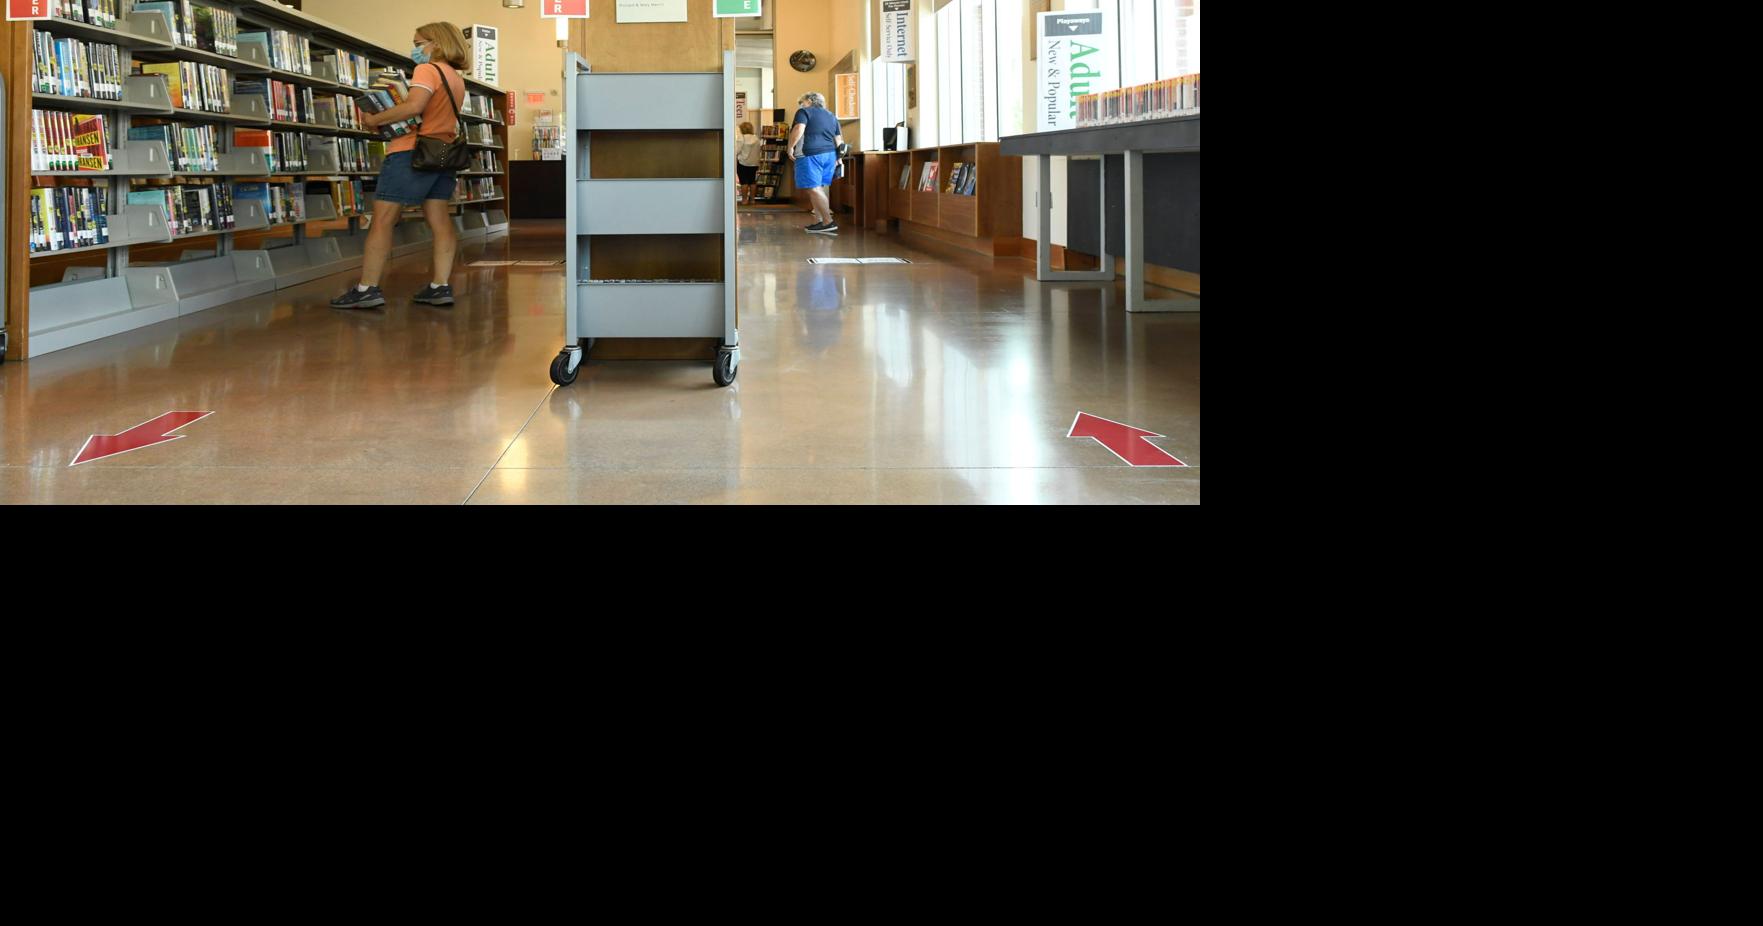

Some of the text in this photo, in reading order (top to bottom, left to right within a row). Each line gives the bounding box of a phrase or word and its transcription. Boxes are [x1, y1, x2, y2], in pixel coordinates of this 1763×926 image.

[485, 41, 496, 81] Adult
[896, 12, 909, 57] Internet
[1044, 40, 1061, 127] New & Popular
[1069, 39, 1101, 119] Adu
